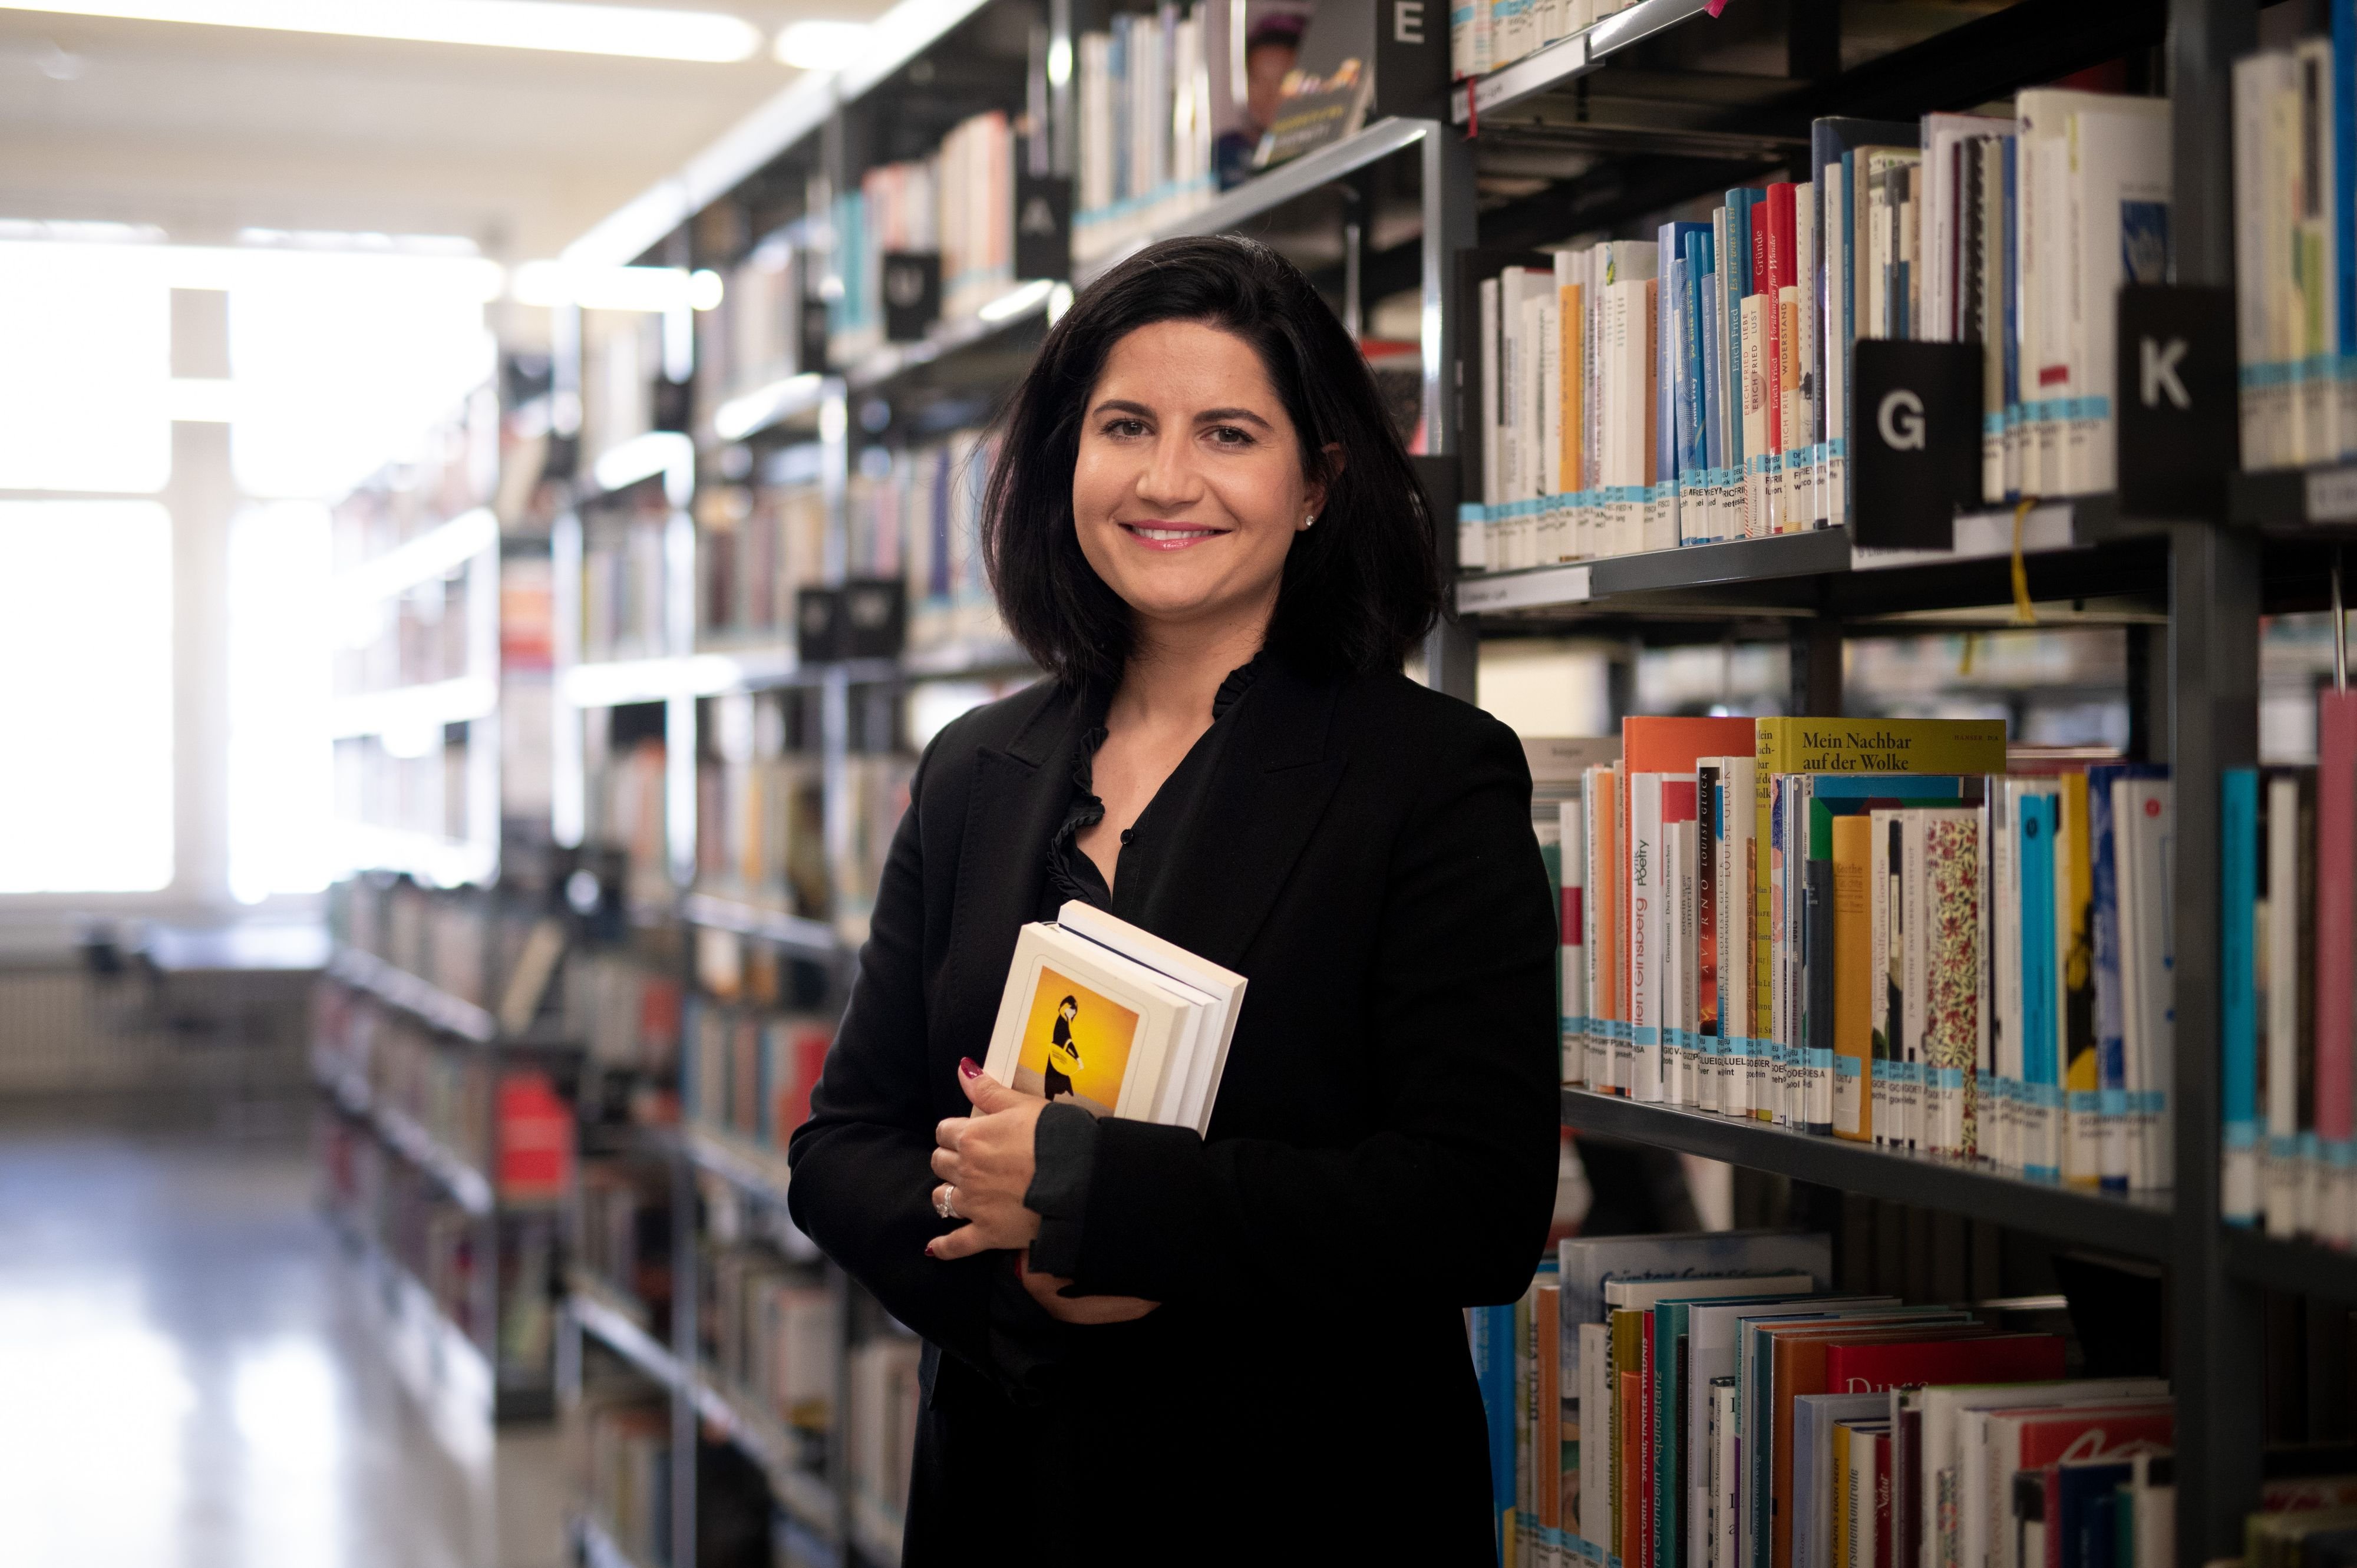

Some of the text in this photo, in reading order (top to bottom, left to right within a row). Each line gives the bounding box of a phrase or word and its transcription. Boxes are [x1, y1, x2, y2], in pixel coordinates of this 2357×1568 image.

[1394, 1, 1425, 43] E
[1727, 206, 1735, 219] ist
[1729, 222, 1736, 231] es
[1754, 230, 1764, 275] Gründe
[1769, 234, 1777, 269] Wunder
[1730, 278, 1738, 289] Es
[1769, 272, 1777, 287] für
[1731, 308, 1739, 336] Fried
[1770, 289, 1779, 341] Vorübungen
[2140, 337, 2193, 410] K
[1877, 389, 1926, 451] G
[1802, 731, 1912, 750] Mein Nachbar
[1803, 753, 1909, 770] auf der Wolke
[1758, 758, 1770, 769] bar
[1638, 840, 1649, 886] Poetry
[1701, 879, 1709, 973] AVERNO
[1634, 897, 1648, 1026] llen Ginsberg
[1877, 1472, 1890, 1517] Natur
[1848, 1469, 1858, 1567] rsonenkontrolle
